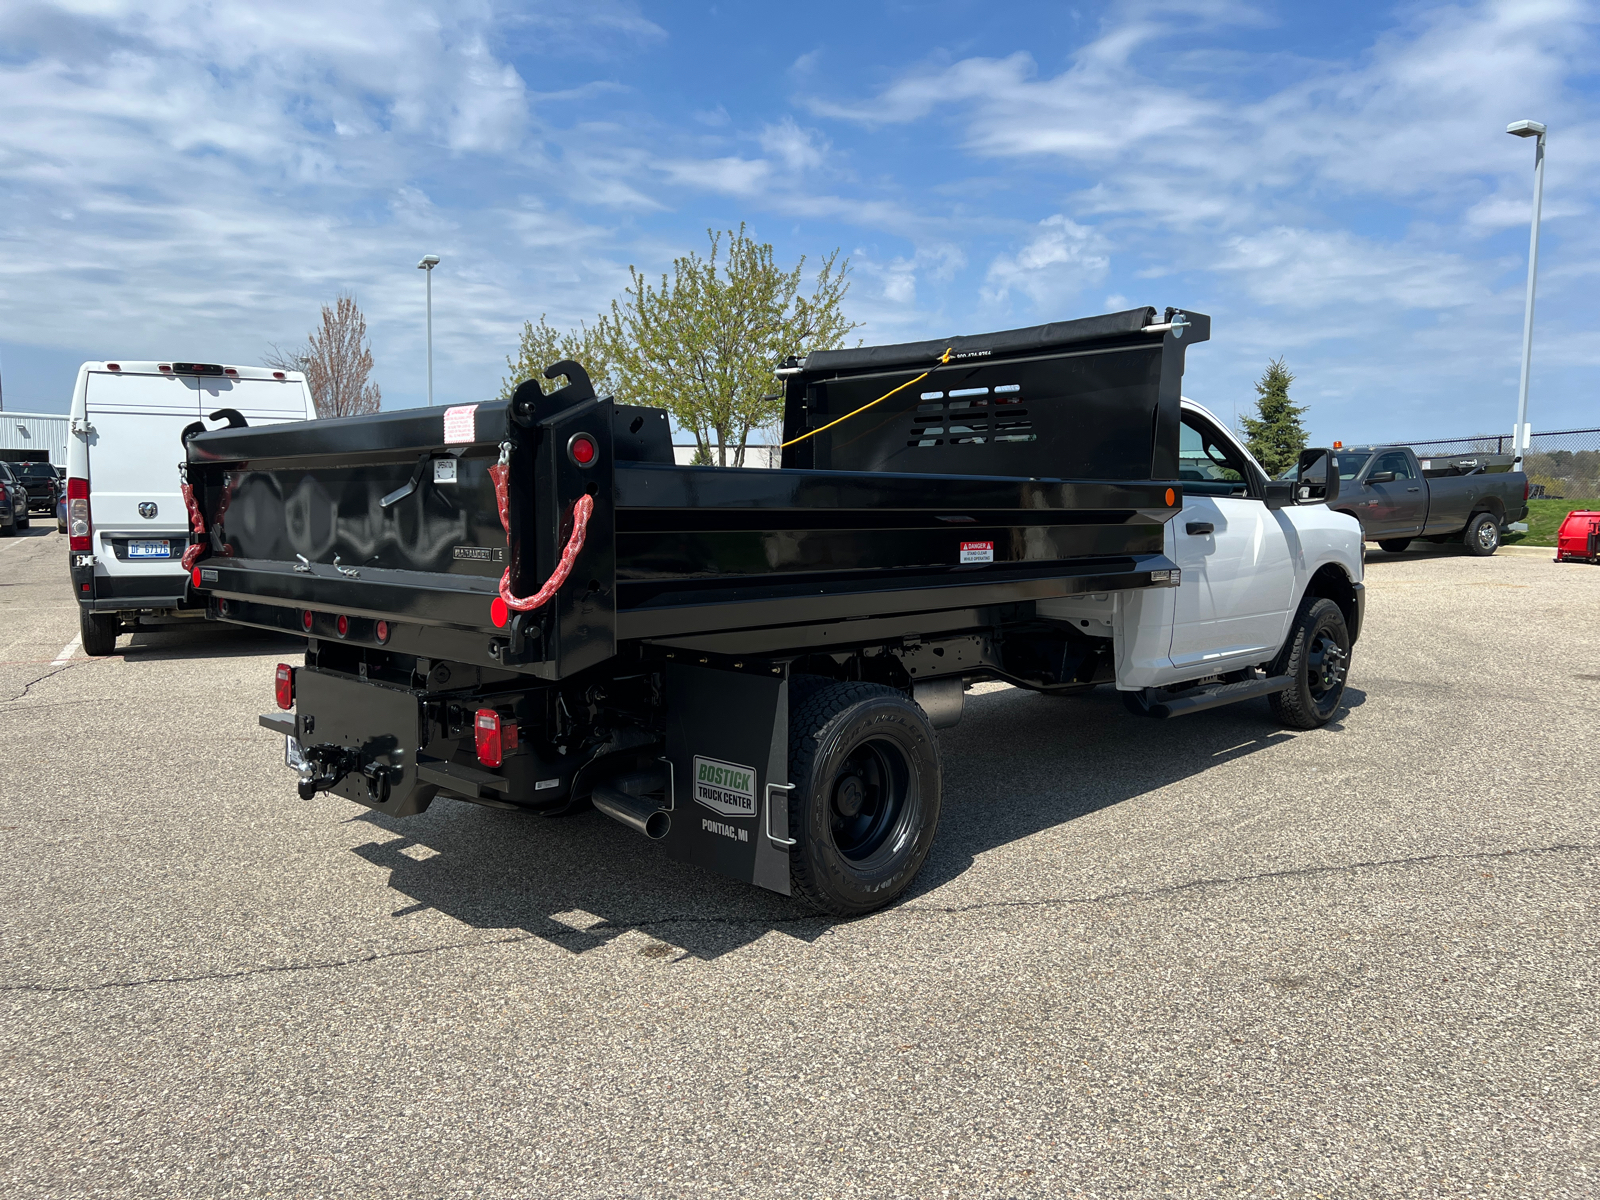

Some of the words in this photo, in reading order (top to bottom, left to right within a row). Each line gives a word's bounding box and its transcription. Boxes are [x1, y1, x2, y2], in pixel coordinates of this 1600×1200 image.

[145, 544, 168, 553] 67176
[836, 714, 926, 754] WRANGLER
[698, 764, 751, 791] BOSTICK
[698, 786, 723, 803] TRUCK
[723, 792, 752, 810] CENTER
[702, 818, 737, 842] PONTIAC,
[737, 828, 748, 842] MI
